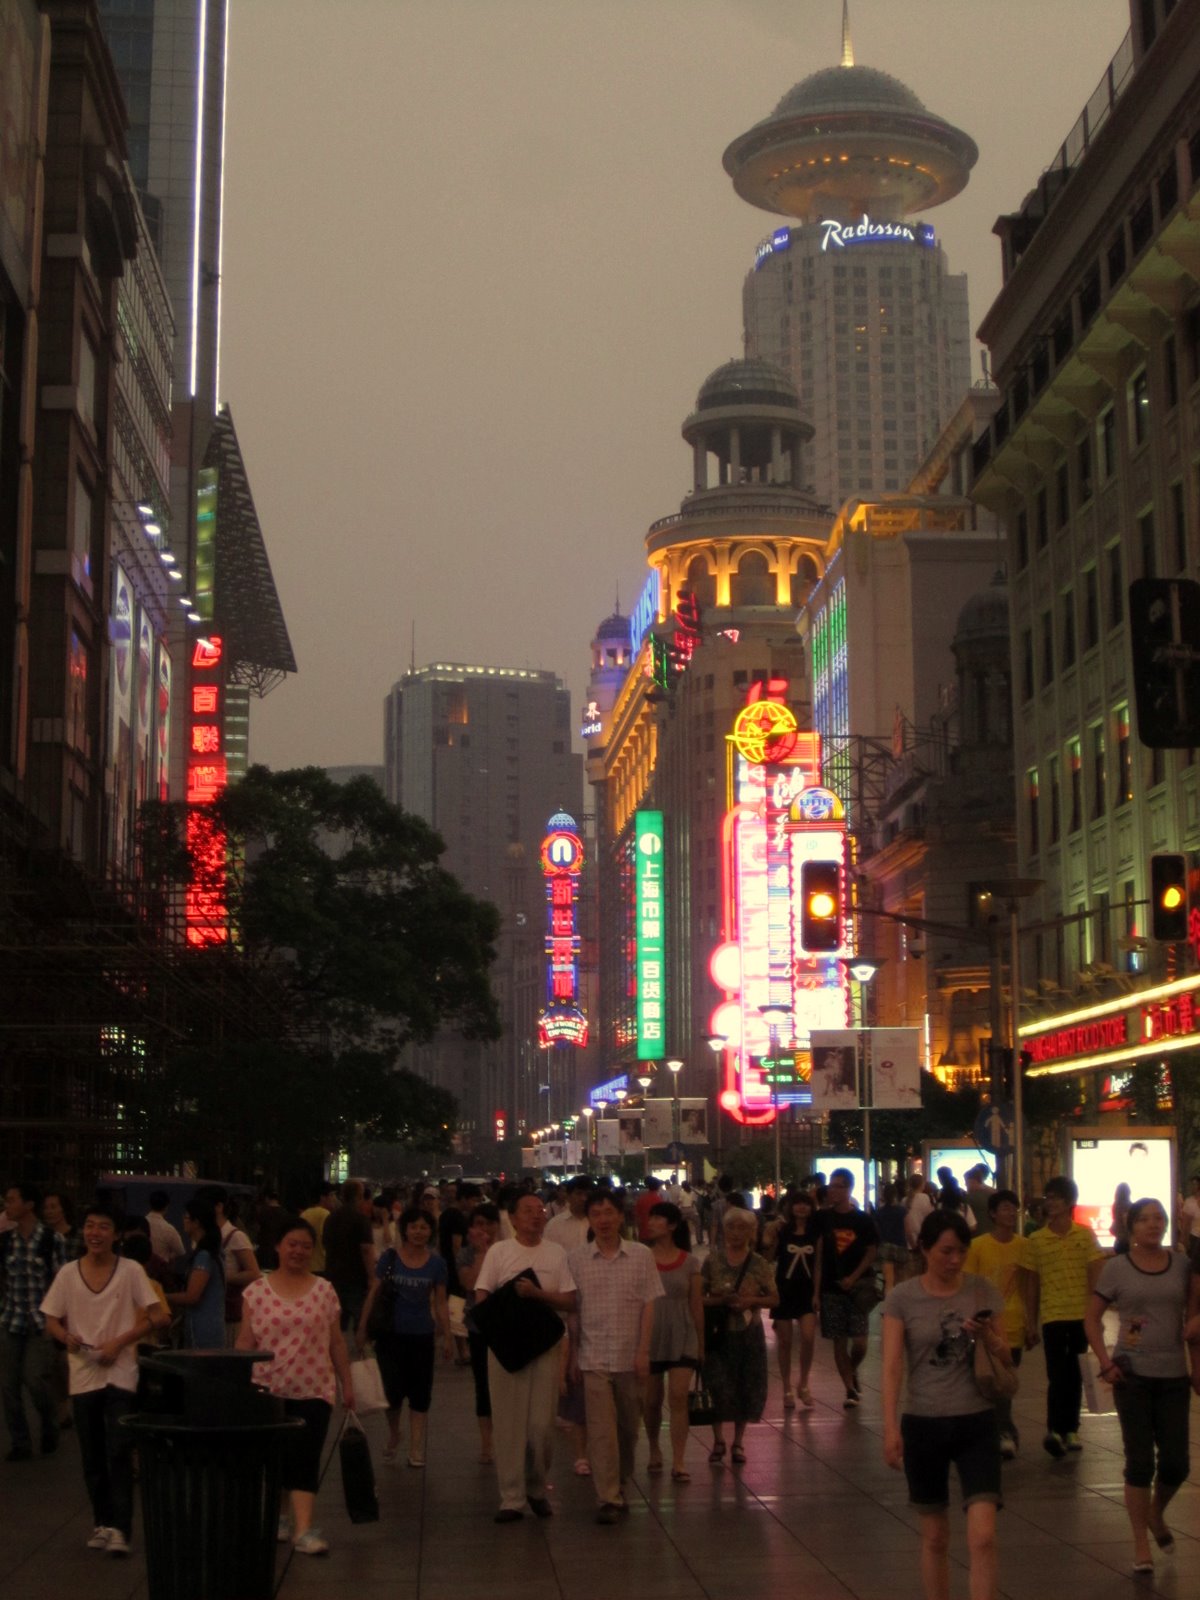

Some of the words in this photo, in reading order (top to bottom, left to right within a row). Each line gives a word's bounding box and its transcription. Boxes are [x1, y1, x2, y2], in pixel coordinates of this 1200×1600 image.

[821, 213, 914, 251] Radisson
[641, 861, 661, 1040] 上海市第一百货商店
[1077, 1021, 1099, 1052] FOOD
[1101, 1014, 1126, 1047] STORE
